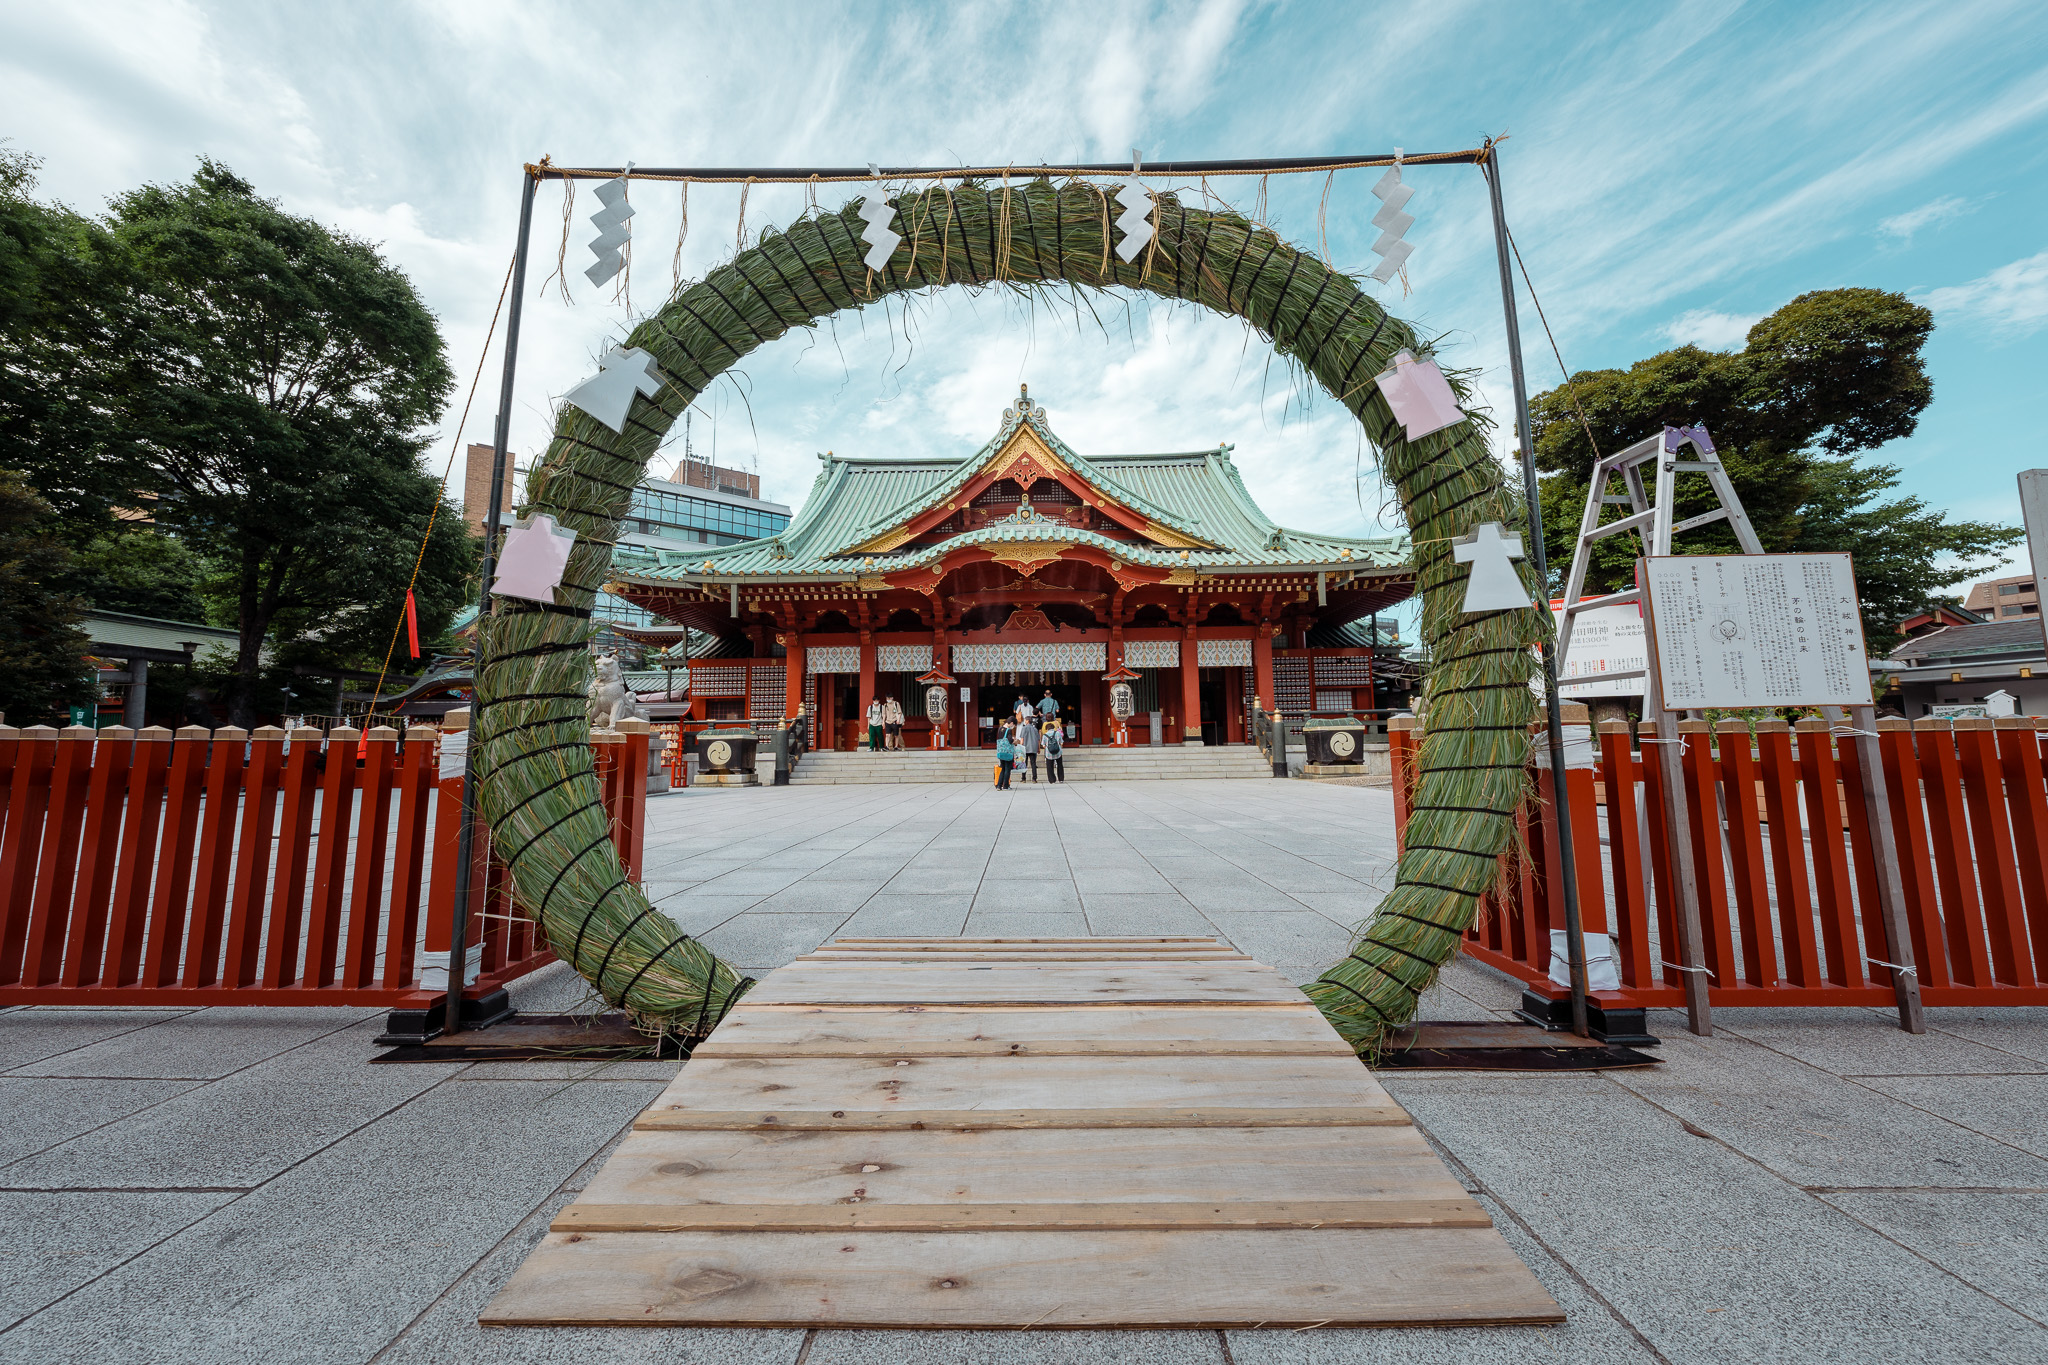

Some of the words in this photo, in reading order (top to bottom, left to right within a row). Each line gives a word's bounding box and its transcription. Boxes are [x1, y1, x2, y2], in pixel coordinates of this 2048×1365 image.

[1792, 597, 1808, 652] 茅の輪の由来
[1840, 597, 1857, 652] 大祓神事
